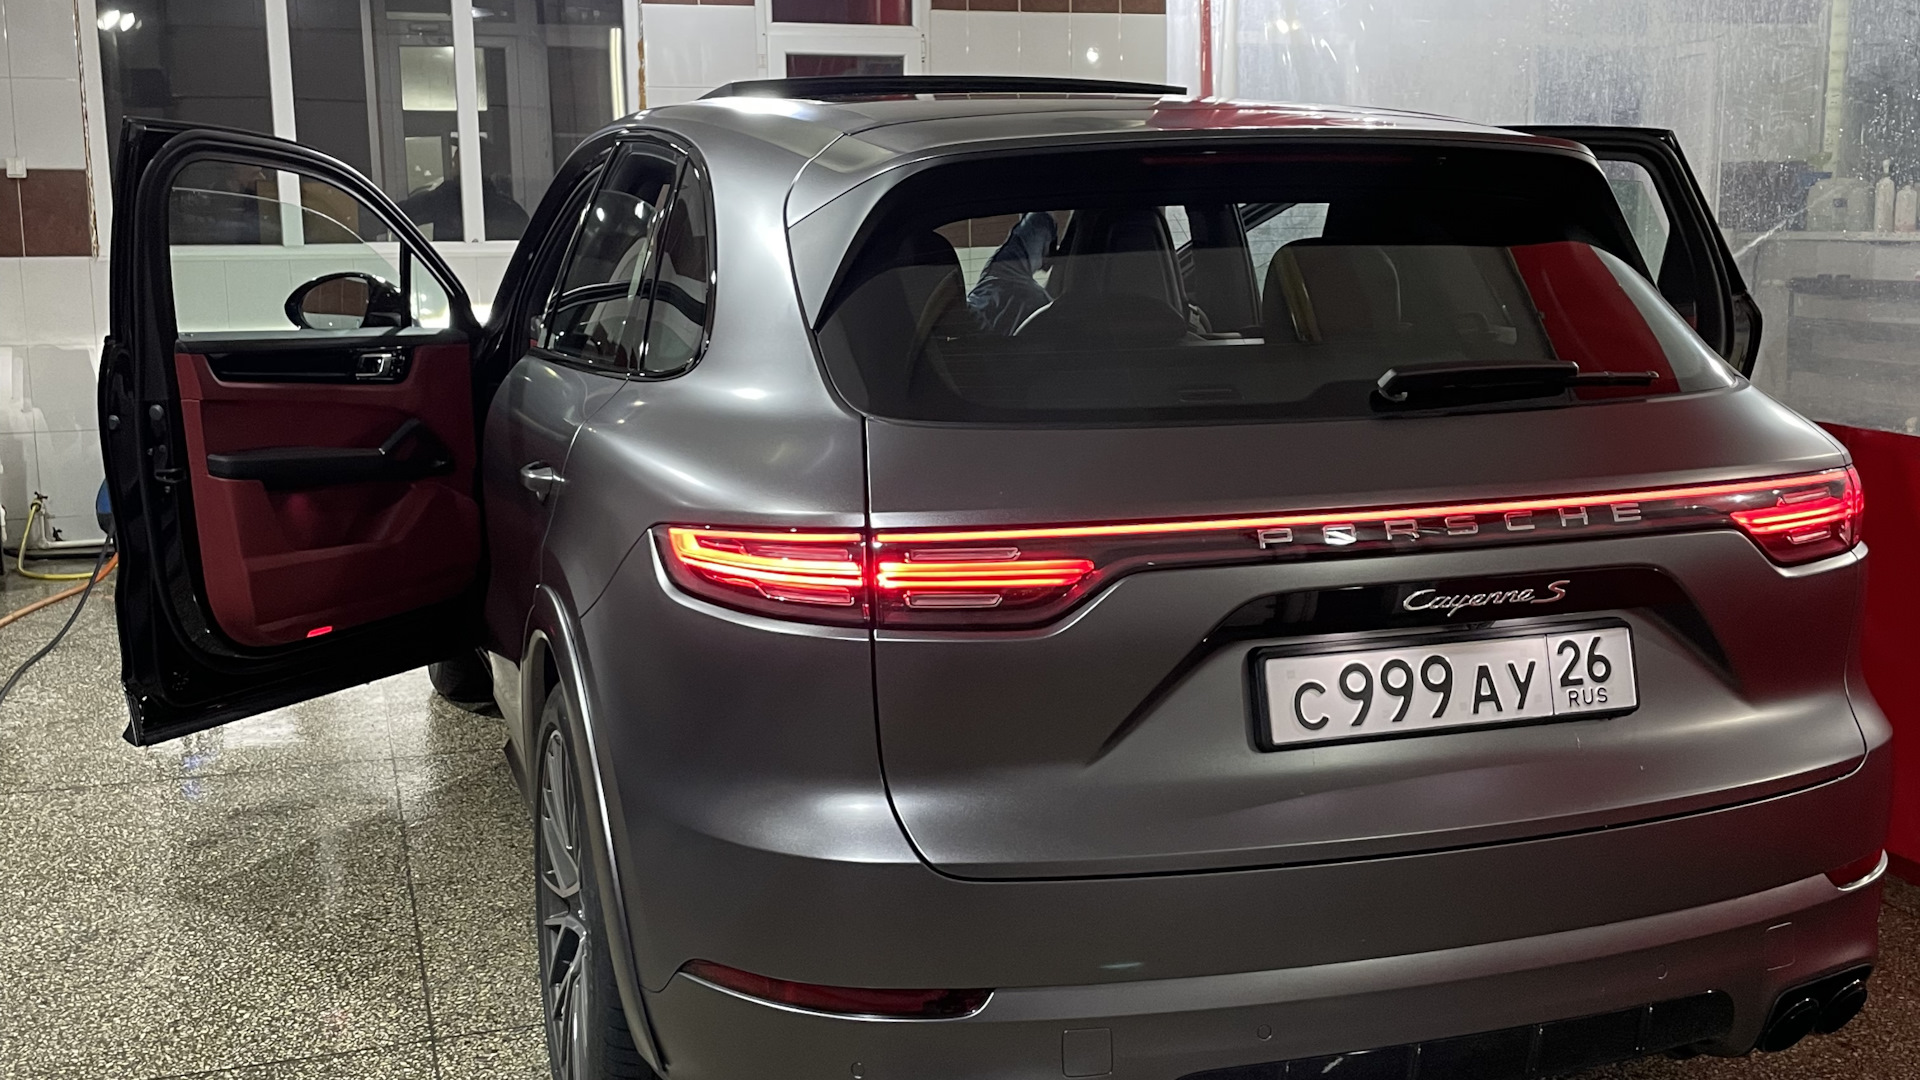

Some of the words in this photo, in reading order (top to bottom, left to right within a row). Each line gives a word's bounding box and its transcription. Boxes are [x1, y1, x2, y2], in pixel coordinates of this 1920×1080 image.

[1257, 502, 1642, 549] PORSCHE
[1402, 588, 1535, 617] Cayenne
[1530, 580, 1571, 604] S
[1557, 637, 1612, 687] 26
[1569, 688, 1608, 707] RUS
